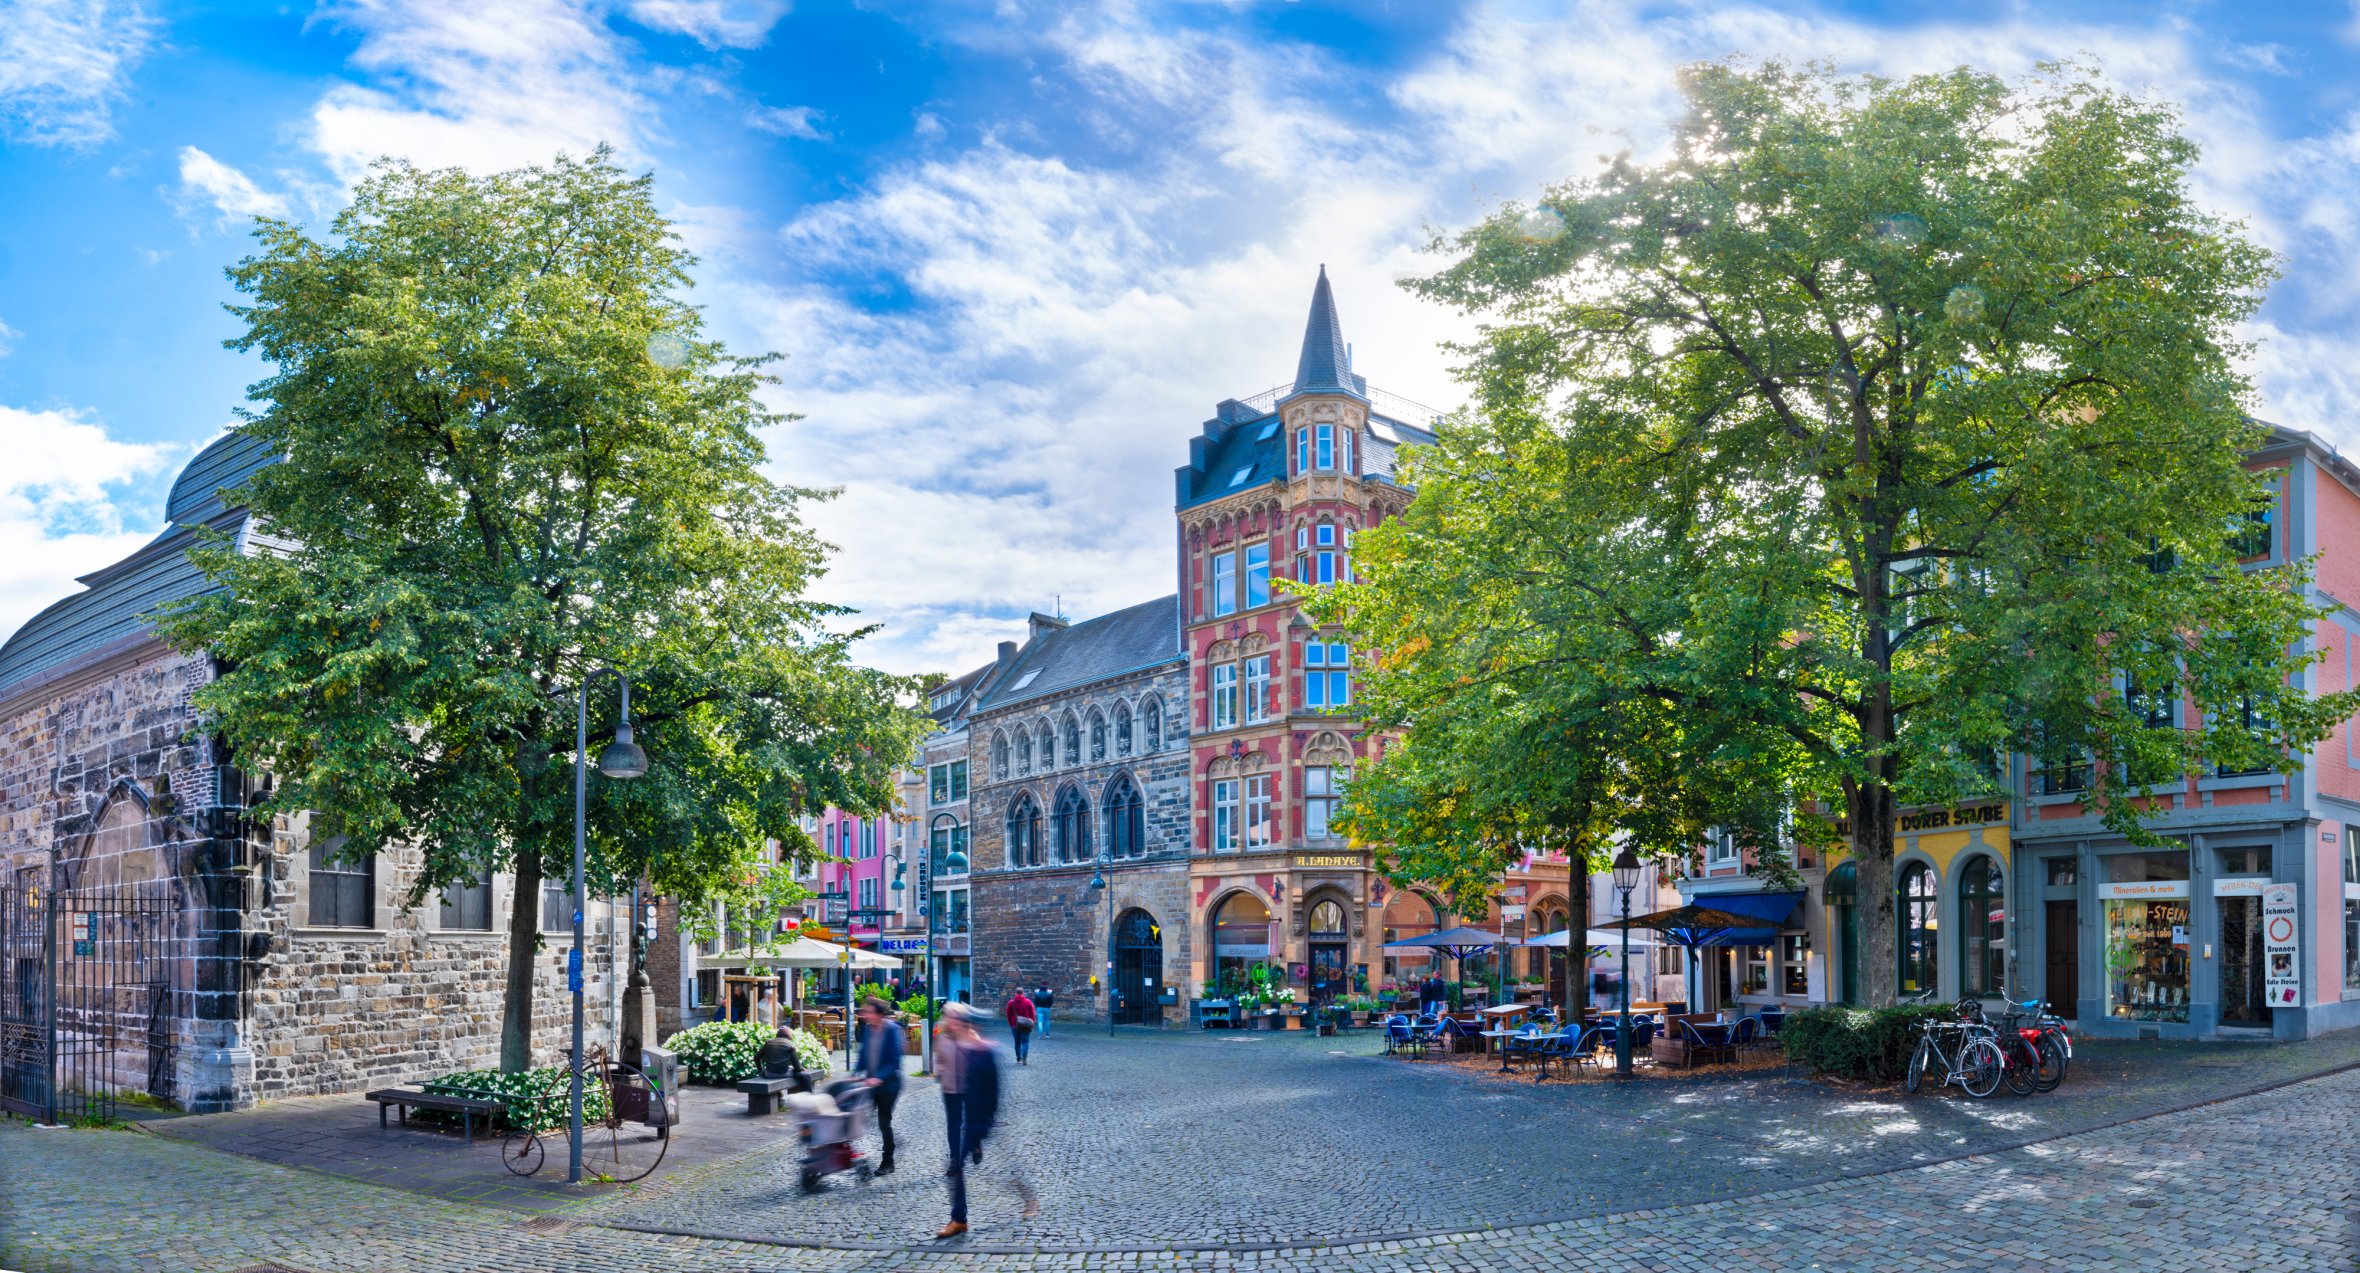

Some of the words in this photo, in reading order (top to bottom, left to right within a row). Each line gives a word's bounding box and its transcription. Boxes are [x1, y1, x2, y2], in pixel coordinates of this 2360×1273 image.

[919, 862, 927, 901] DESIGN
[2113, 886, 2148, 894] Mineralien
[2149, 885, 2156, 893] &
[2157, 885, 2175, 893] mehr
[2265, 906, 2295, 915] Schmuck
[882, 939, 926, 950] DELHE
[1255, 969, 1266, 978] 10
